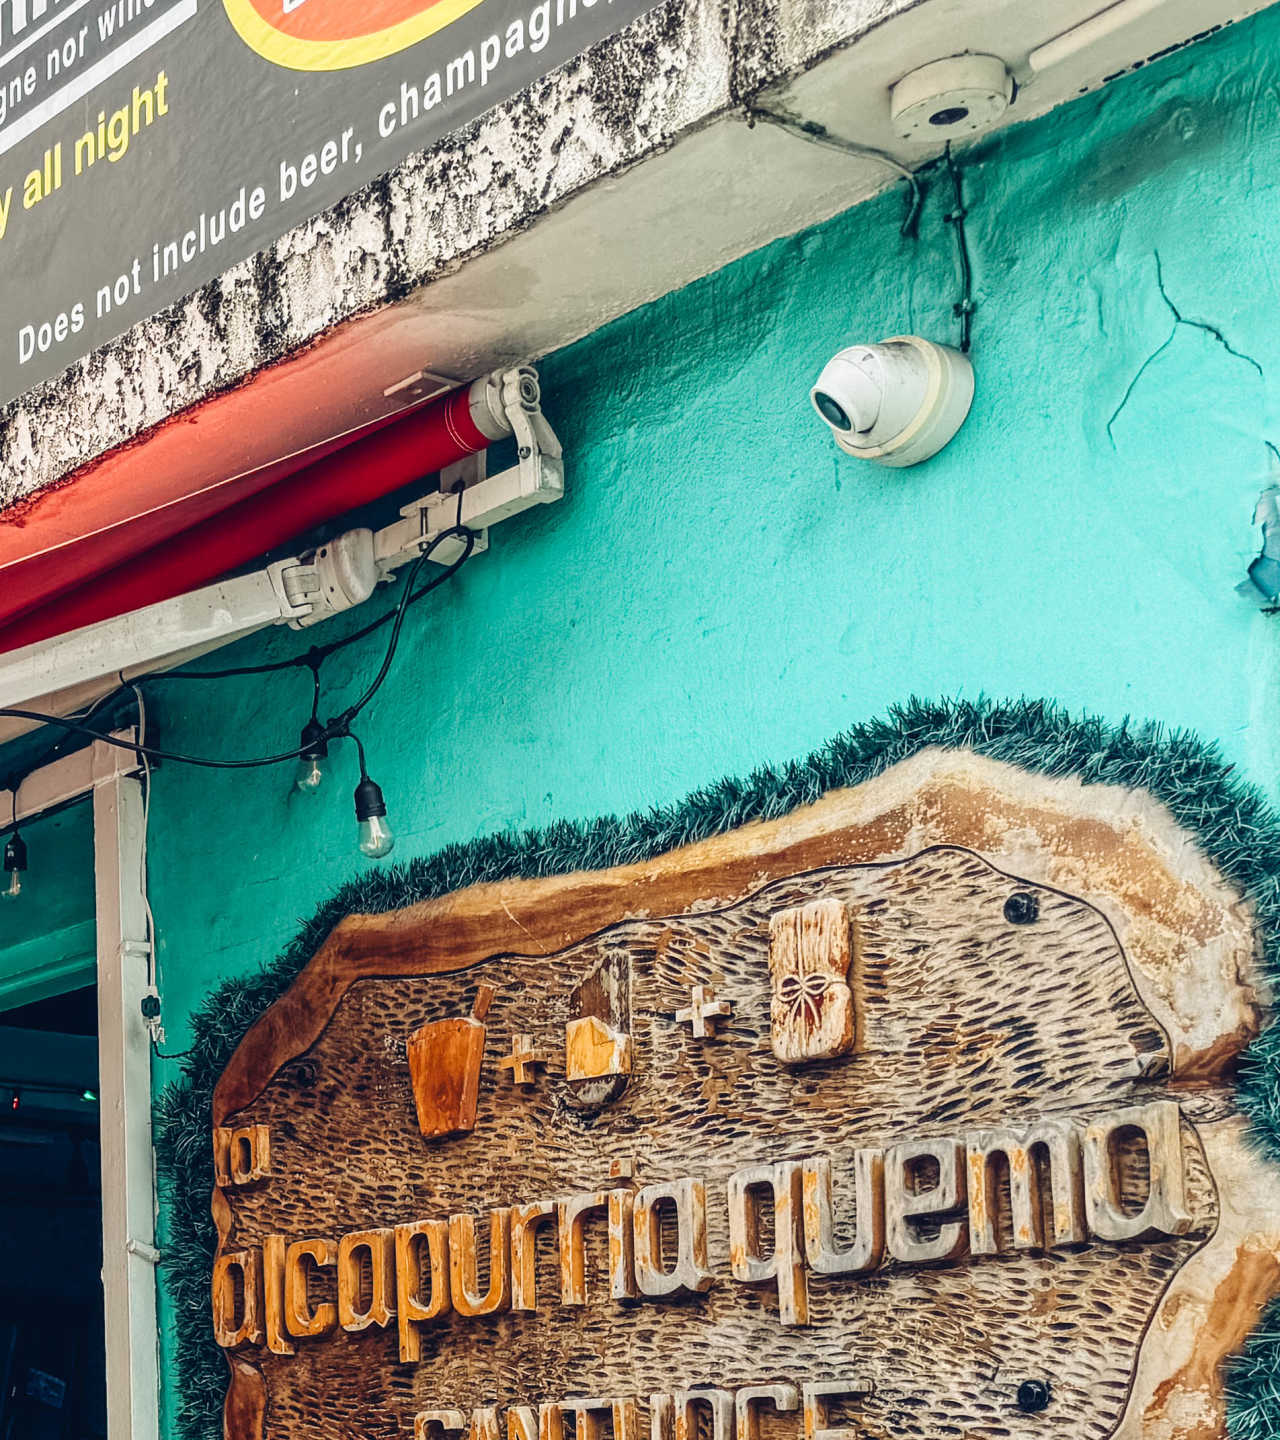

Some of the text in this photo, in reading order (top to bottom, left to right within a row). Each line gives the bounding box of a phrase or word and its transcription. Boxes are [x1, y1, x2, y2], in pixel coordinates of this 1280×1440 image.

[46, 30, 88, 81] nor
[98, 0, 154, 42] win
[18, 0, 613, 364] Does not include beer, champagn
[23, 147, 62, 209] all
[72, 70, 169, 176] night
[212, 1123, 272, 1188] la
[211, 1097, 1194, 1363] alcapurria quema
